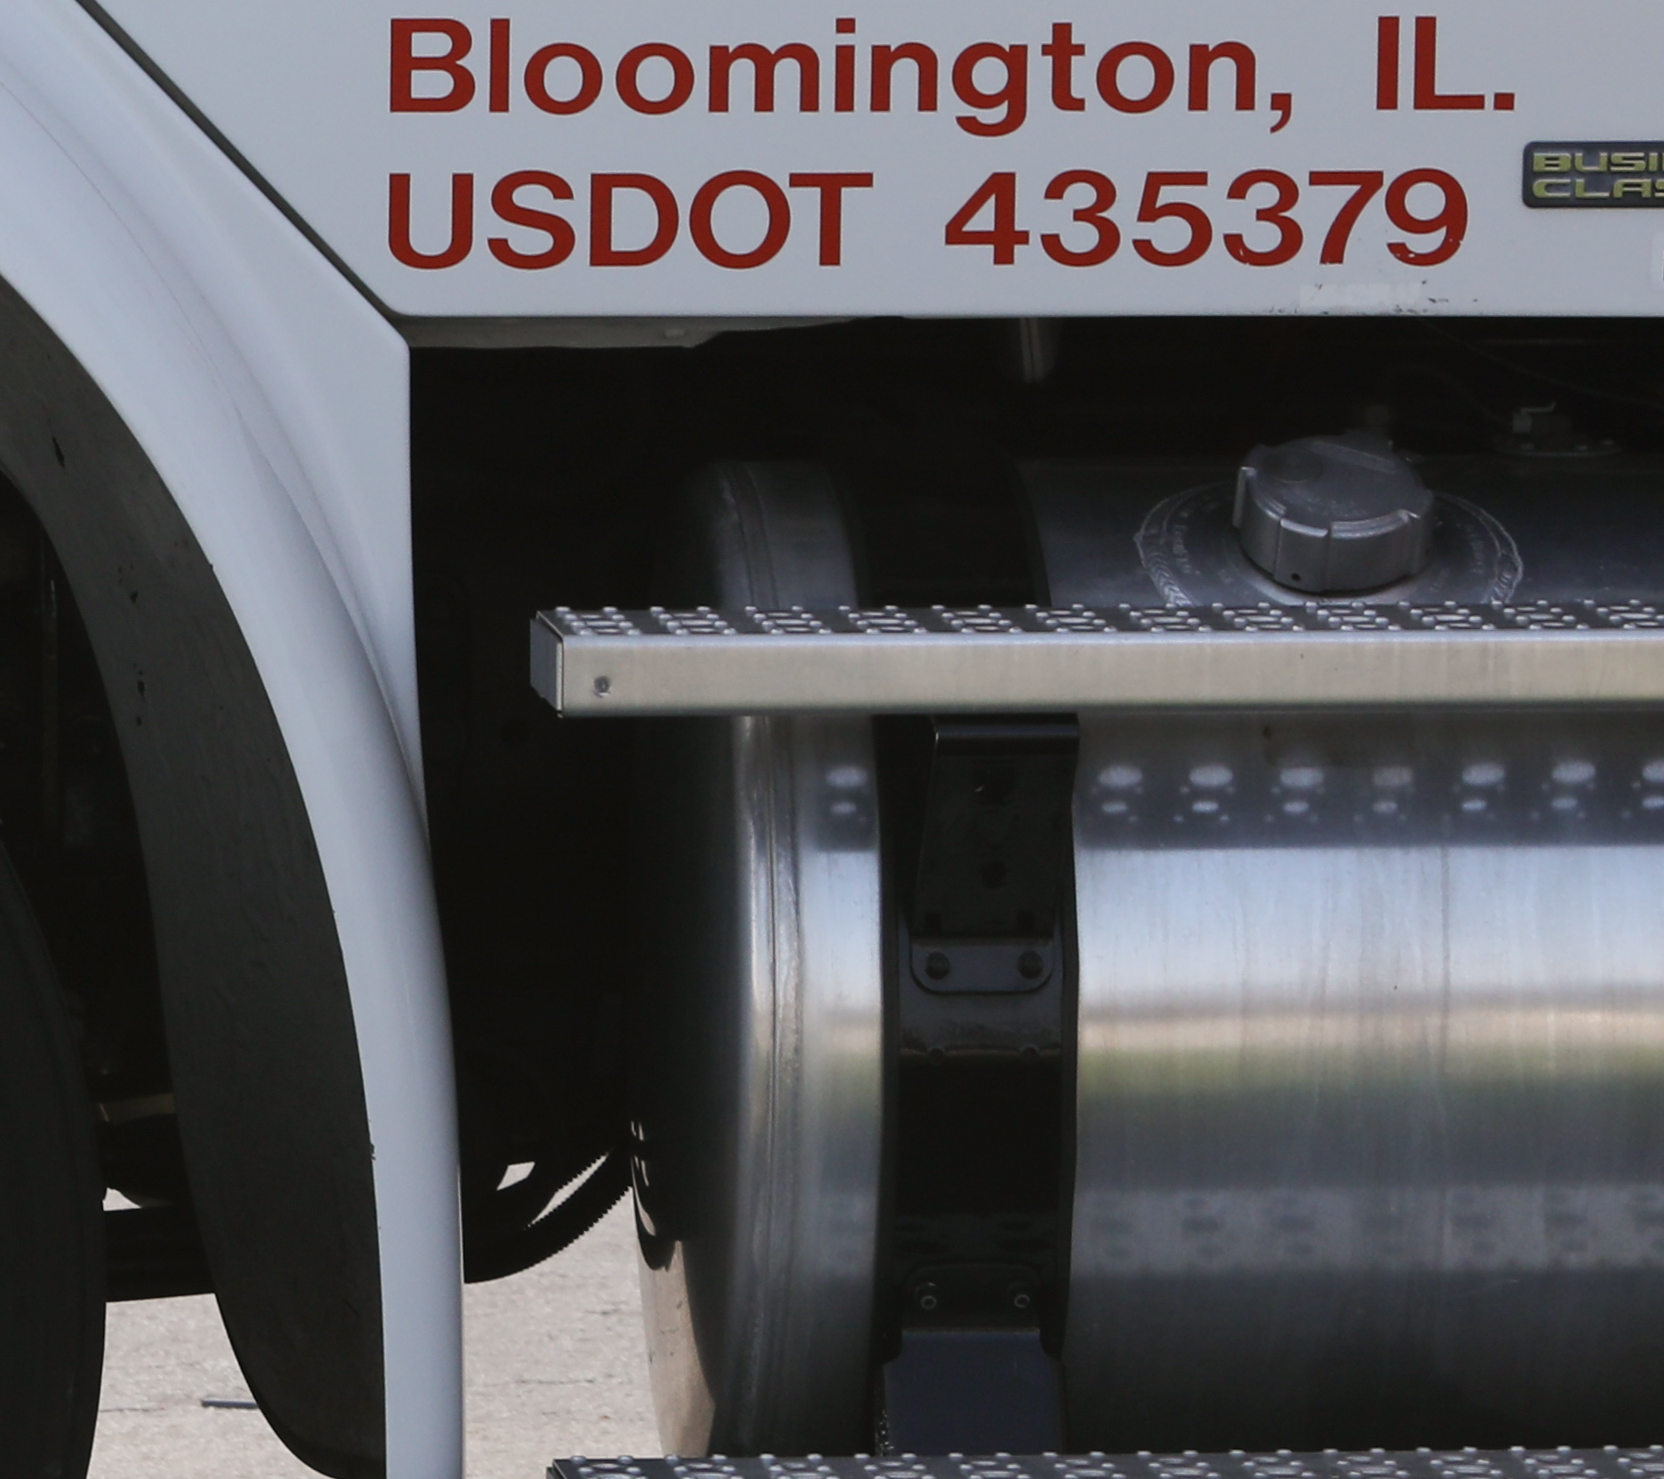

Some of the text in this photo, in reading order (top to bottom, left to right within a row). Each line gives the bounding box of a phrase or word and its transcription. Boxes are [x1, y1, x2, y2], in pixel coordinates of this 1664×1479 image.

[392, 18, 1514, 136] Bloomington, IL.
[1532, 151, 1664, 173] BUSI
[391, 170, 1467, 268] USDOT 435379
